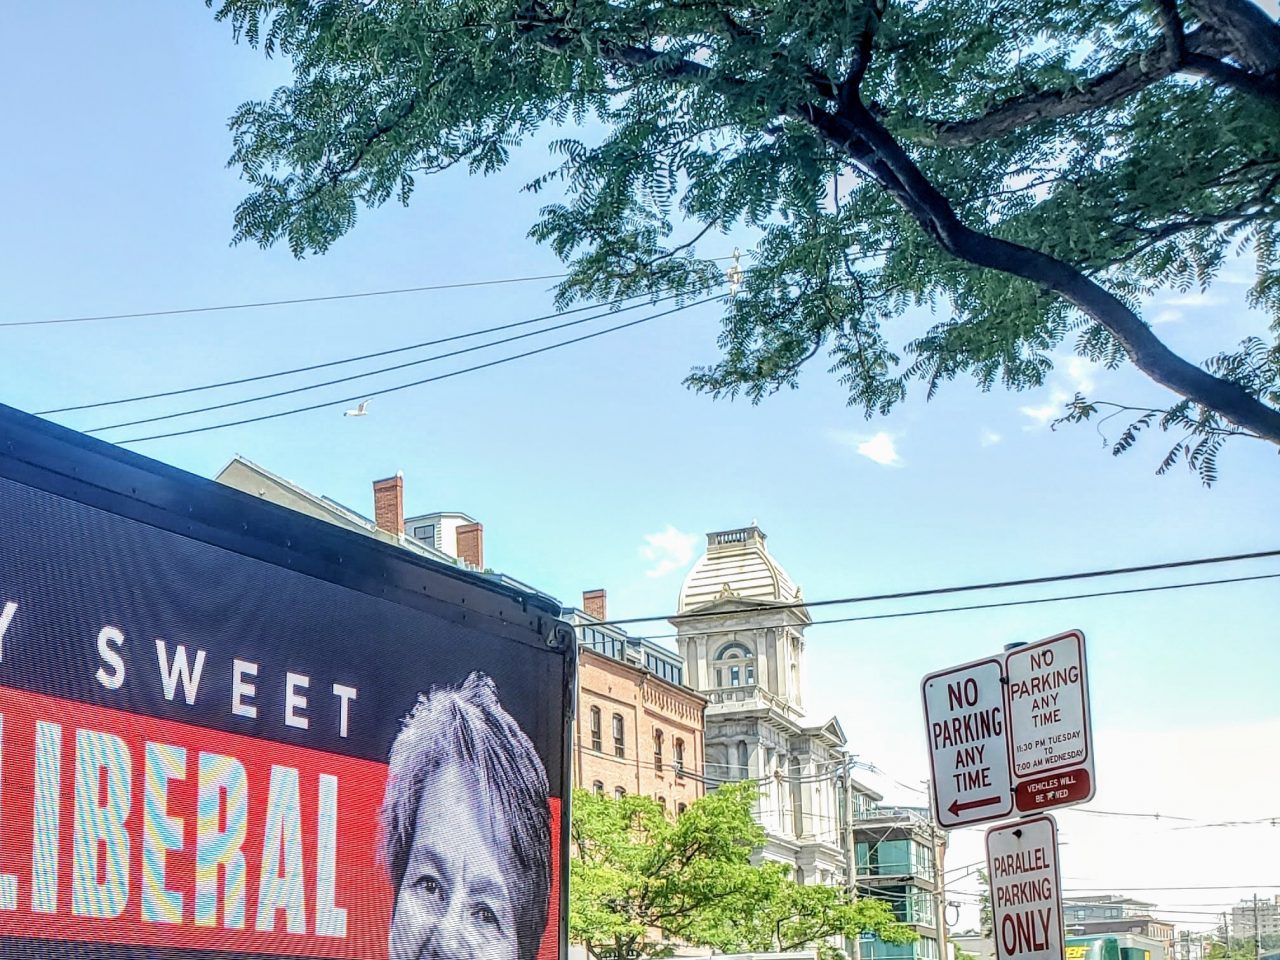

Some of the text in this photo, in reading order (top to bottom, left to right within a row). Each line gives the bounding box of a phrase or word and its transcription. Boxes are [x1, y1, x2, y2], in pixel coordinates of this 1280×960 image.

[1030, 649, 1054, 672] NO
[95, 625, 358, 738] SWEET
[947, 678, 978, 711] NO
[1010, 666, 1079, 702] PARKING
[1032, 692, 1059, 712] ANY
[933, 707, 1002, 750] PARKING
[1032, 709, 1061, 728] TIME
[1035, 737, 1046, 748] PM
[1048, 730, 1081, 744] TUESDAY
[1044, 746, 1053, 755] TO
[955, 744, 985, 770] ANY
[1033, 757, 1043, 768] AM
[1045, 749, 1084, 765] WEDNESDAY
[952, 767, 991, 793] TIME
[1027, 775, 1076, 793] VEHICLES WILL
[1035, 789, 1069, 803] BE TWED
[993, 847, 1050, 879] PARALLEL
[997, 877, 1052, 908] PARKING
[1001, 907, 1052, 956] ONLY
